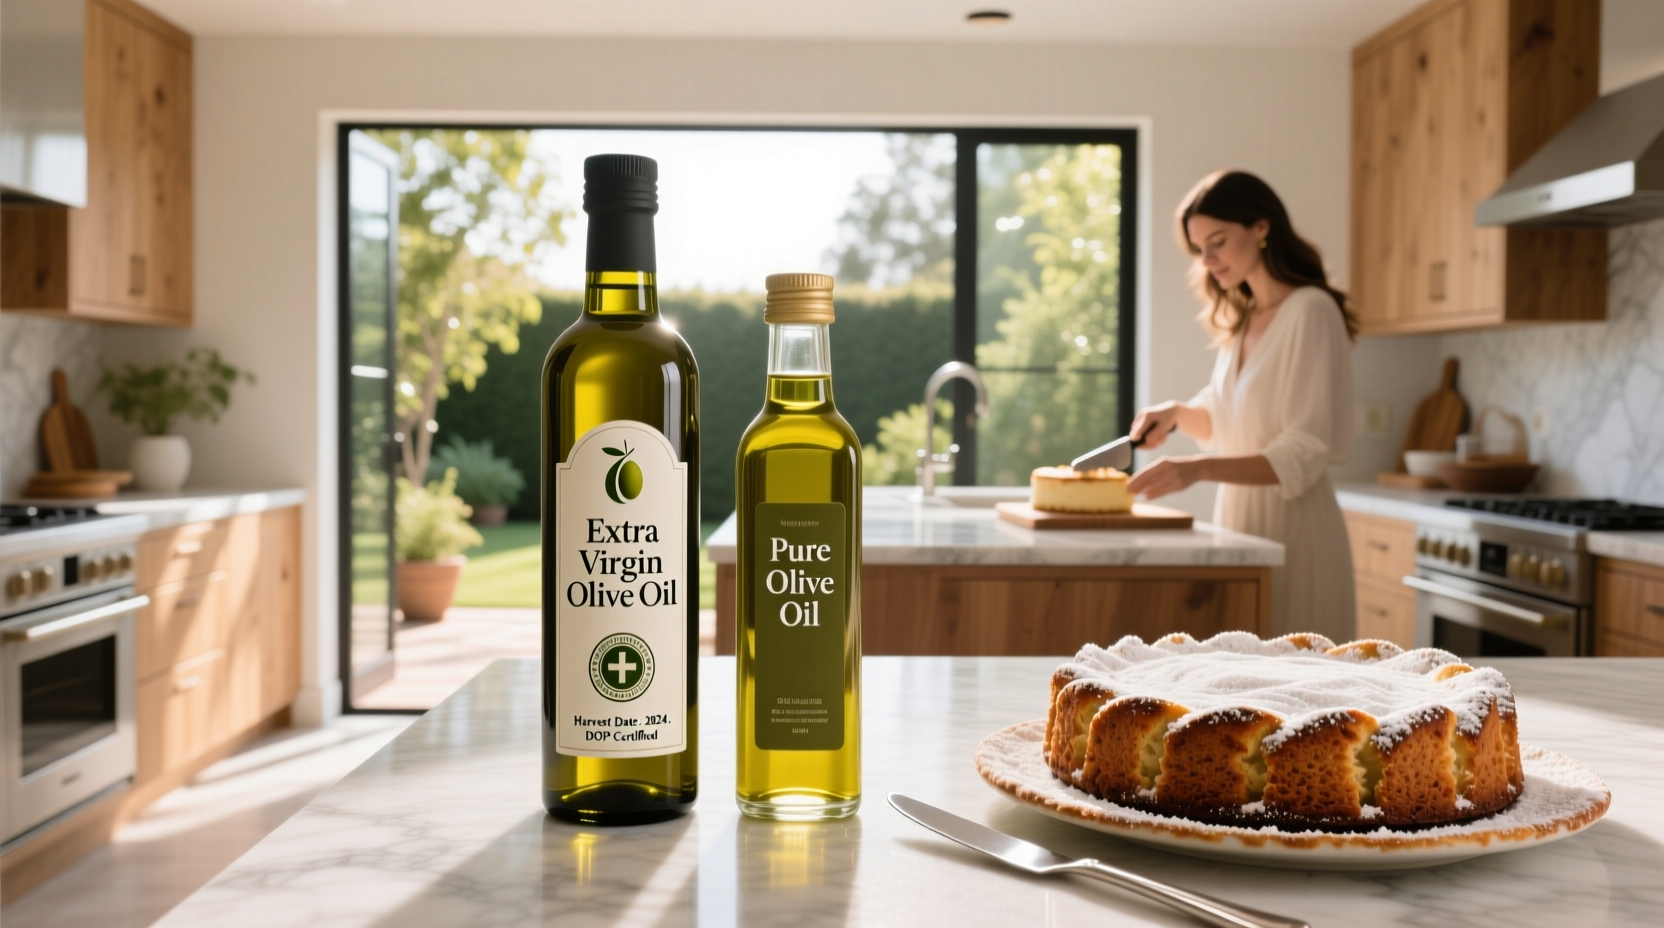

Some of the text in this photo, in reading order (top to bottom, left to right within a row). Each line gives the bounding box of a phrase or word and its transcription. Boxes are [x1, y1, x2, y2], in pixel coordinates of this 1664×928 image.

[586, 518, 660, 543] Extra
[770, 537, 831, 562] Pure
[578, 549, 663, 583] Virgin
[566, 579, 677, 608] Olive Oil
[766, 569, 835, 595] Olive
[780, 600, 820, 627] Oil
[574, 715, 611, 727] Harvest
[585, 731, 611, 742] DOP
